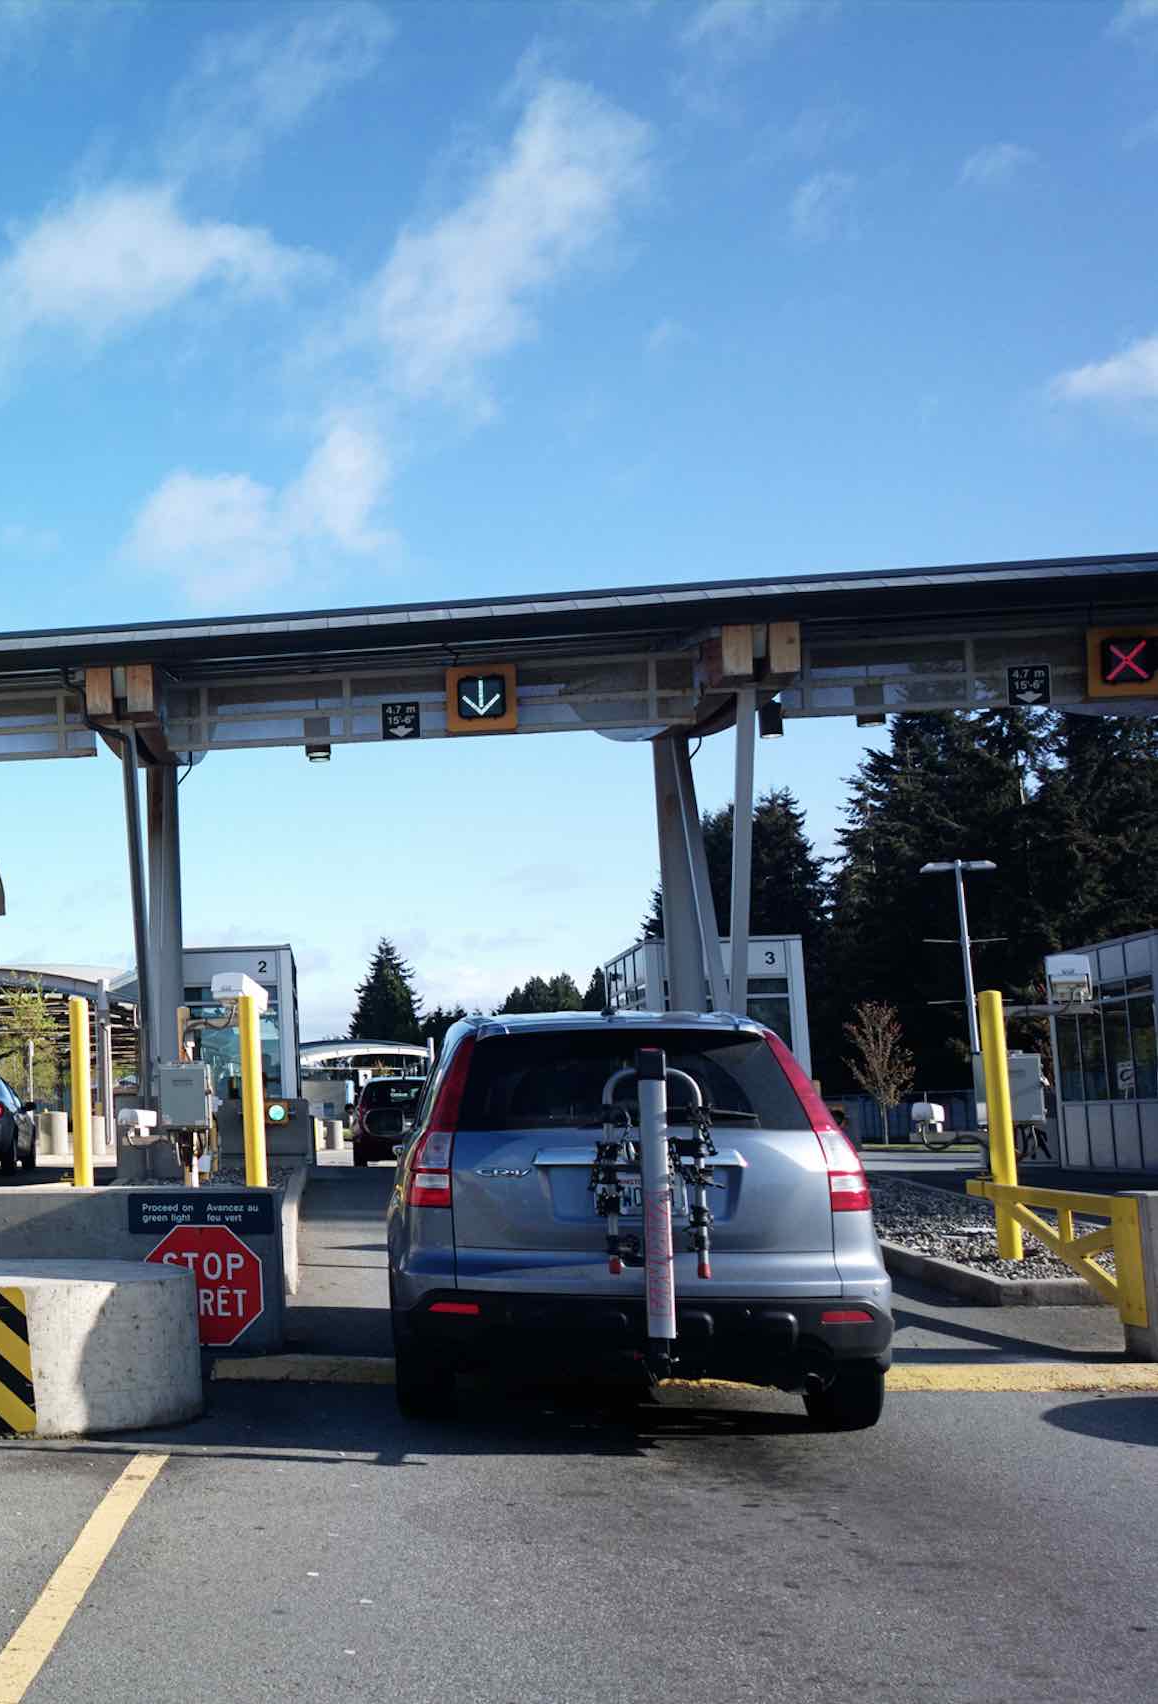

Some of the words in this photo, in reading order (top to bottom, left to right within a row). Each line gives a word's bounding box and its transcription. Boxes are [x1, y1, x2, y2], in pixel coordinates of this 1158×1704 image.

[1034, 669, 1045, 678] m
[406, 705, 416, 713] m
[764, 951, 775, 965] 3
[258, 960, 267, 973] 2
[142, 1203, 179, 1212] Proceed
[182, 1204, 194, 1212] on
[206, 1203, 244, 1212] Avancez
[247, 1204, 259, 1212] au
[142, 1214, 168, 1223] green
[171, 1213, 192, 1223] light
[224, 1214, 242, 1222] vert
[199, 1285, 247, 1317] RÊT
